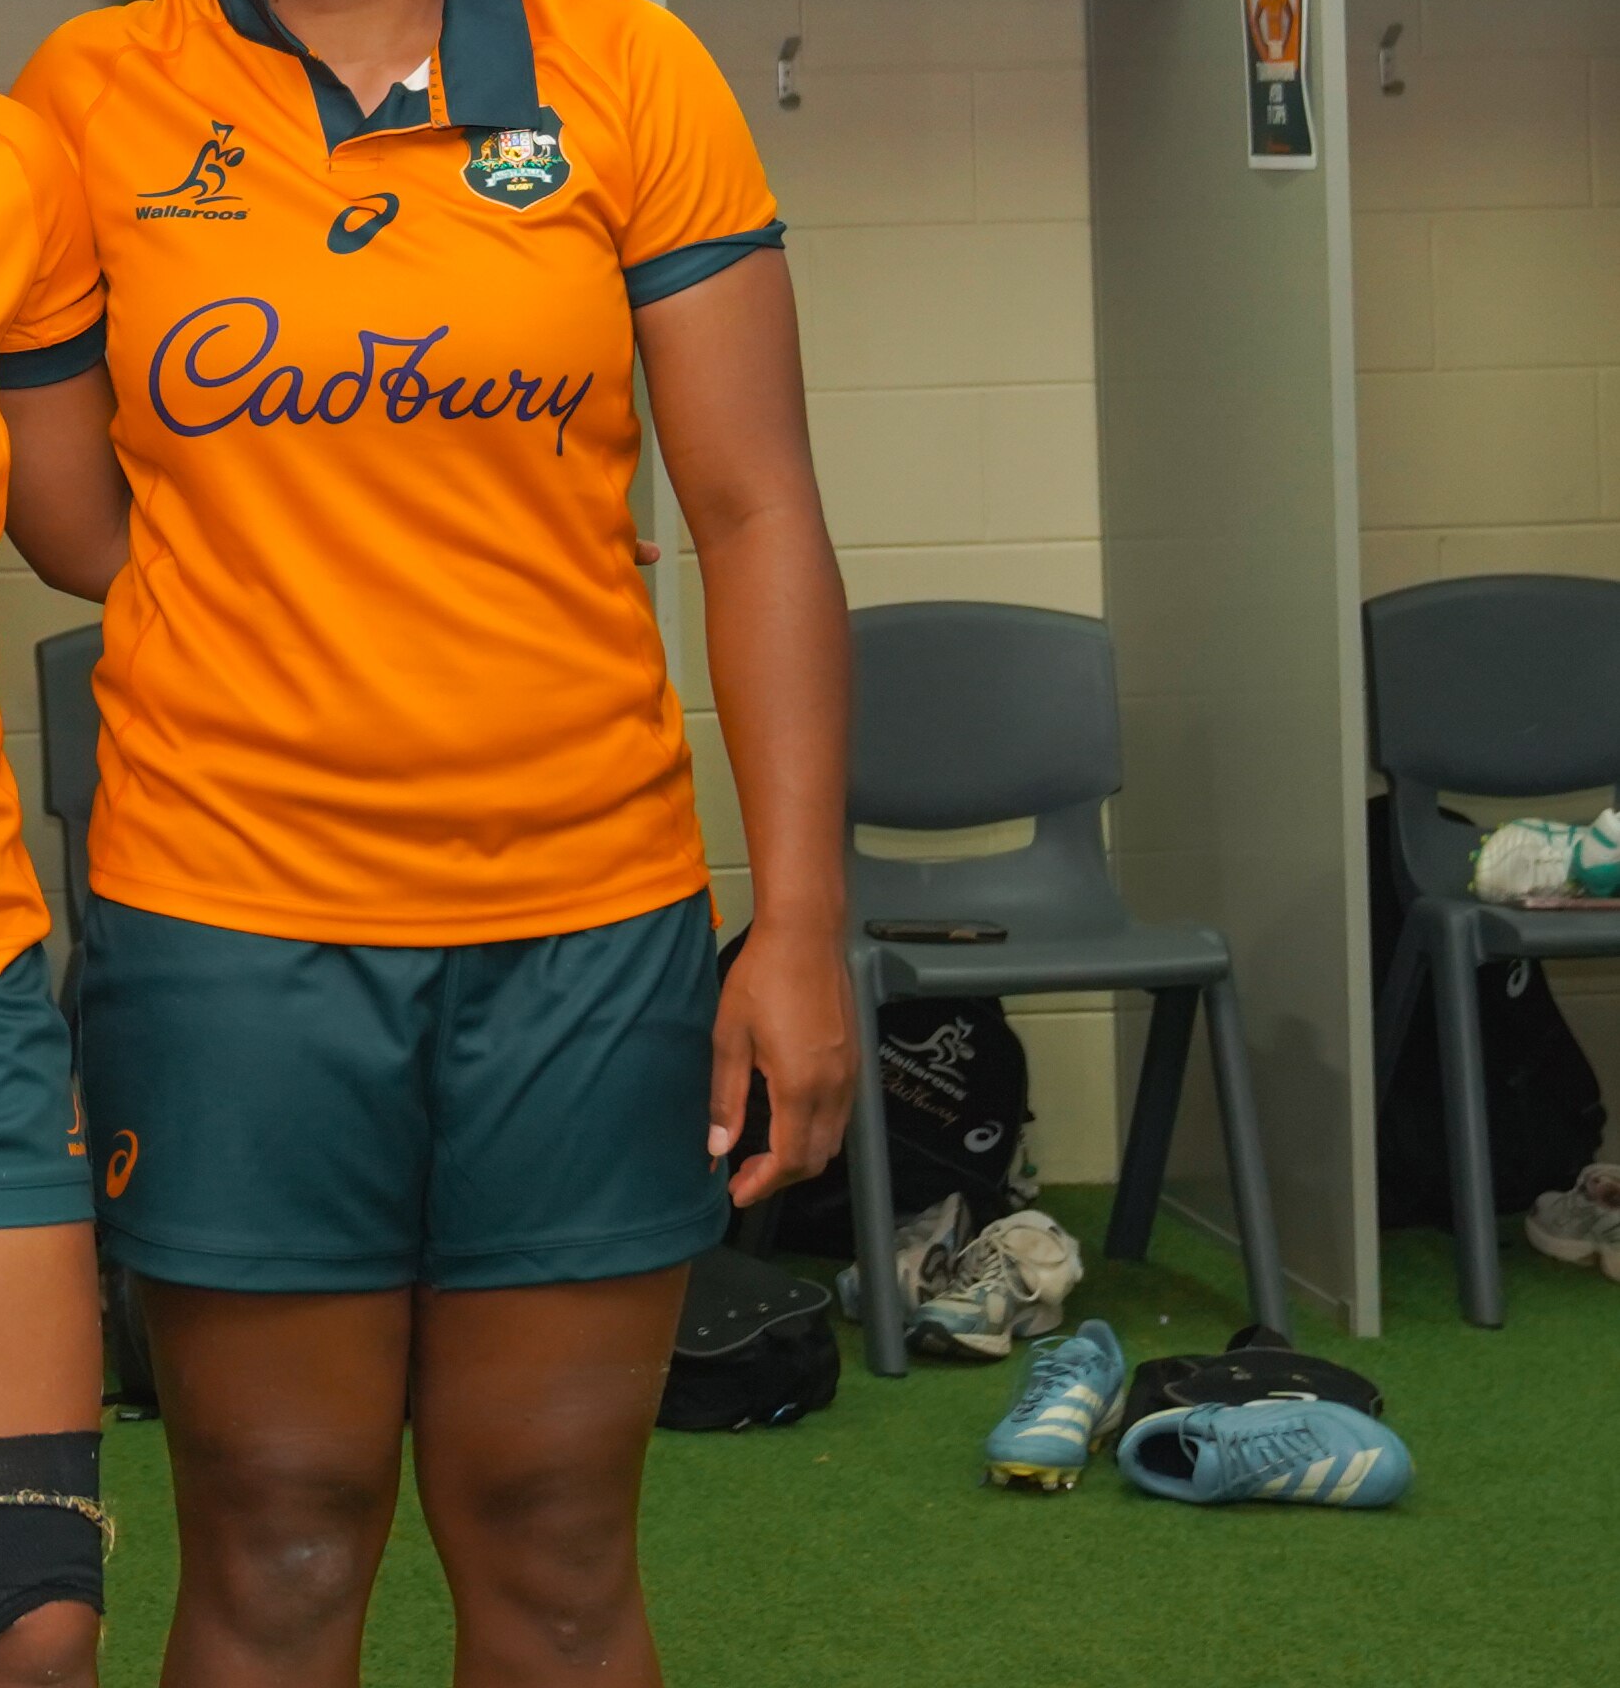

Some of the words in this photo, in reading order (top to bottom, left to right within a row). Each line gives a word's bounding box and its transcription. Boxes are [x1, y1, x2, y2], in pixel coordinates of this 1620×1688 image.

[136, 206, 247, 220] Wallaroos
[149, 297, 594, 456] Cadbury
[880, 1043, 967, 1101] Wallaroos
